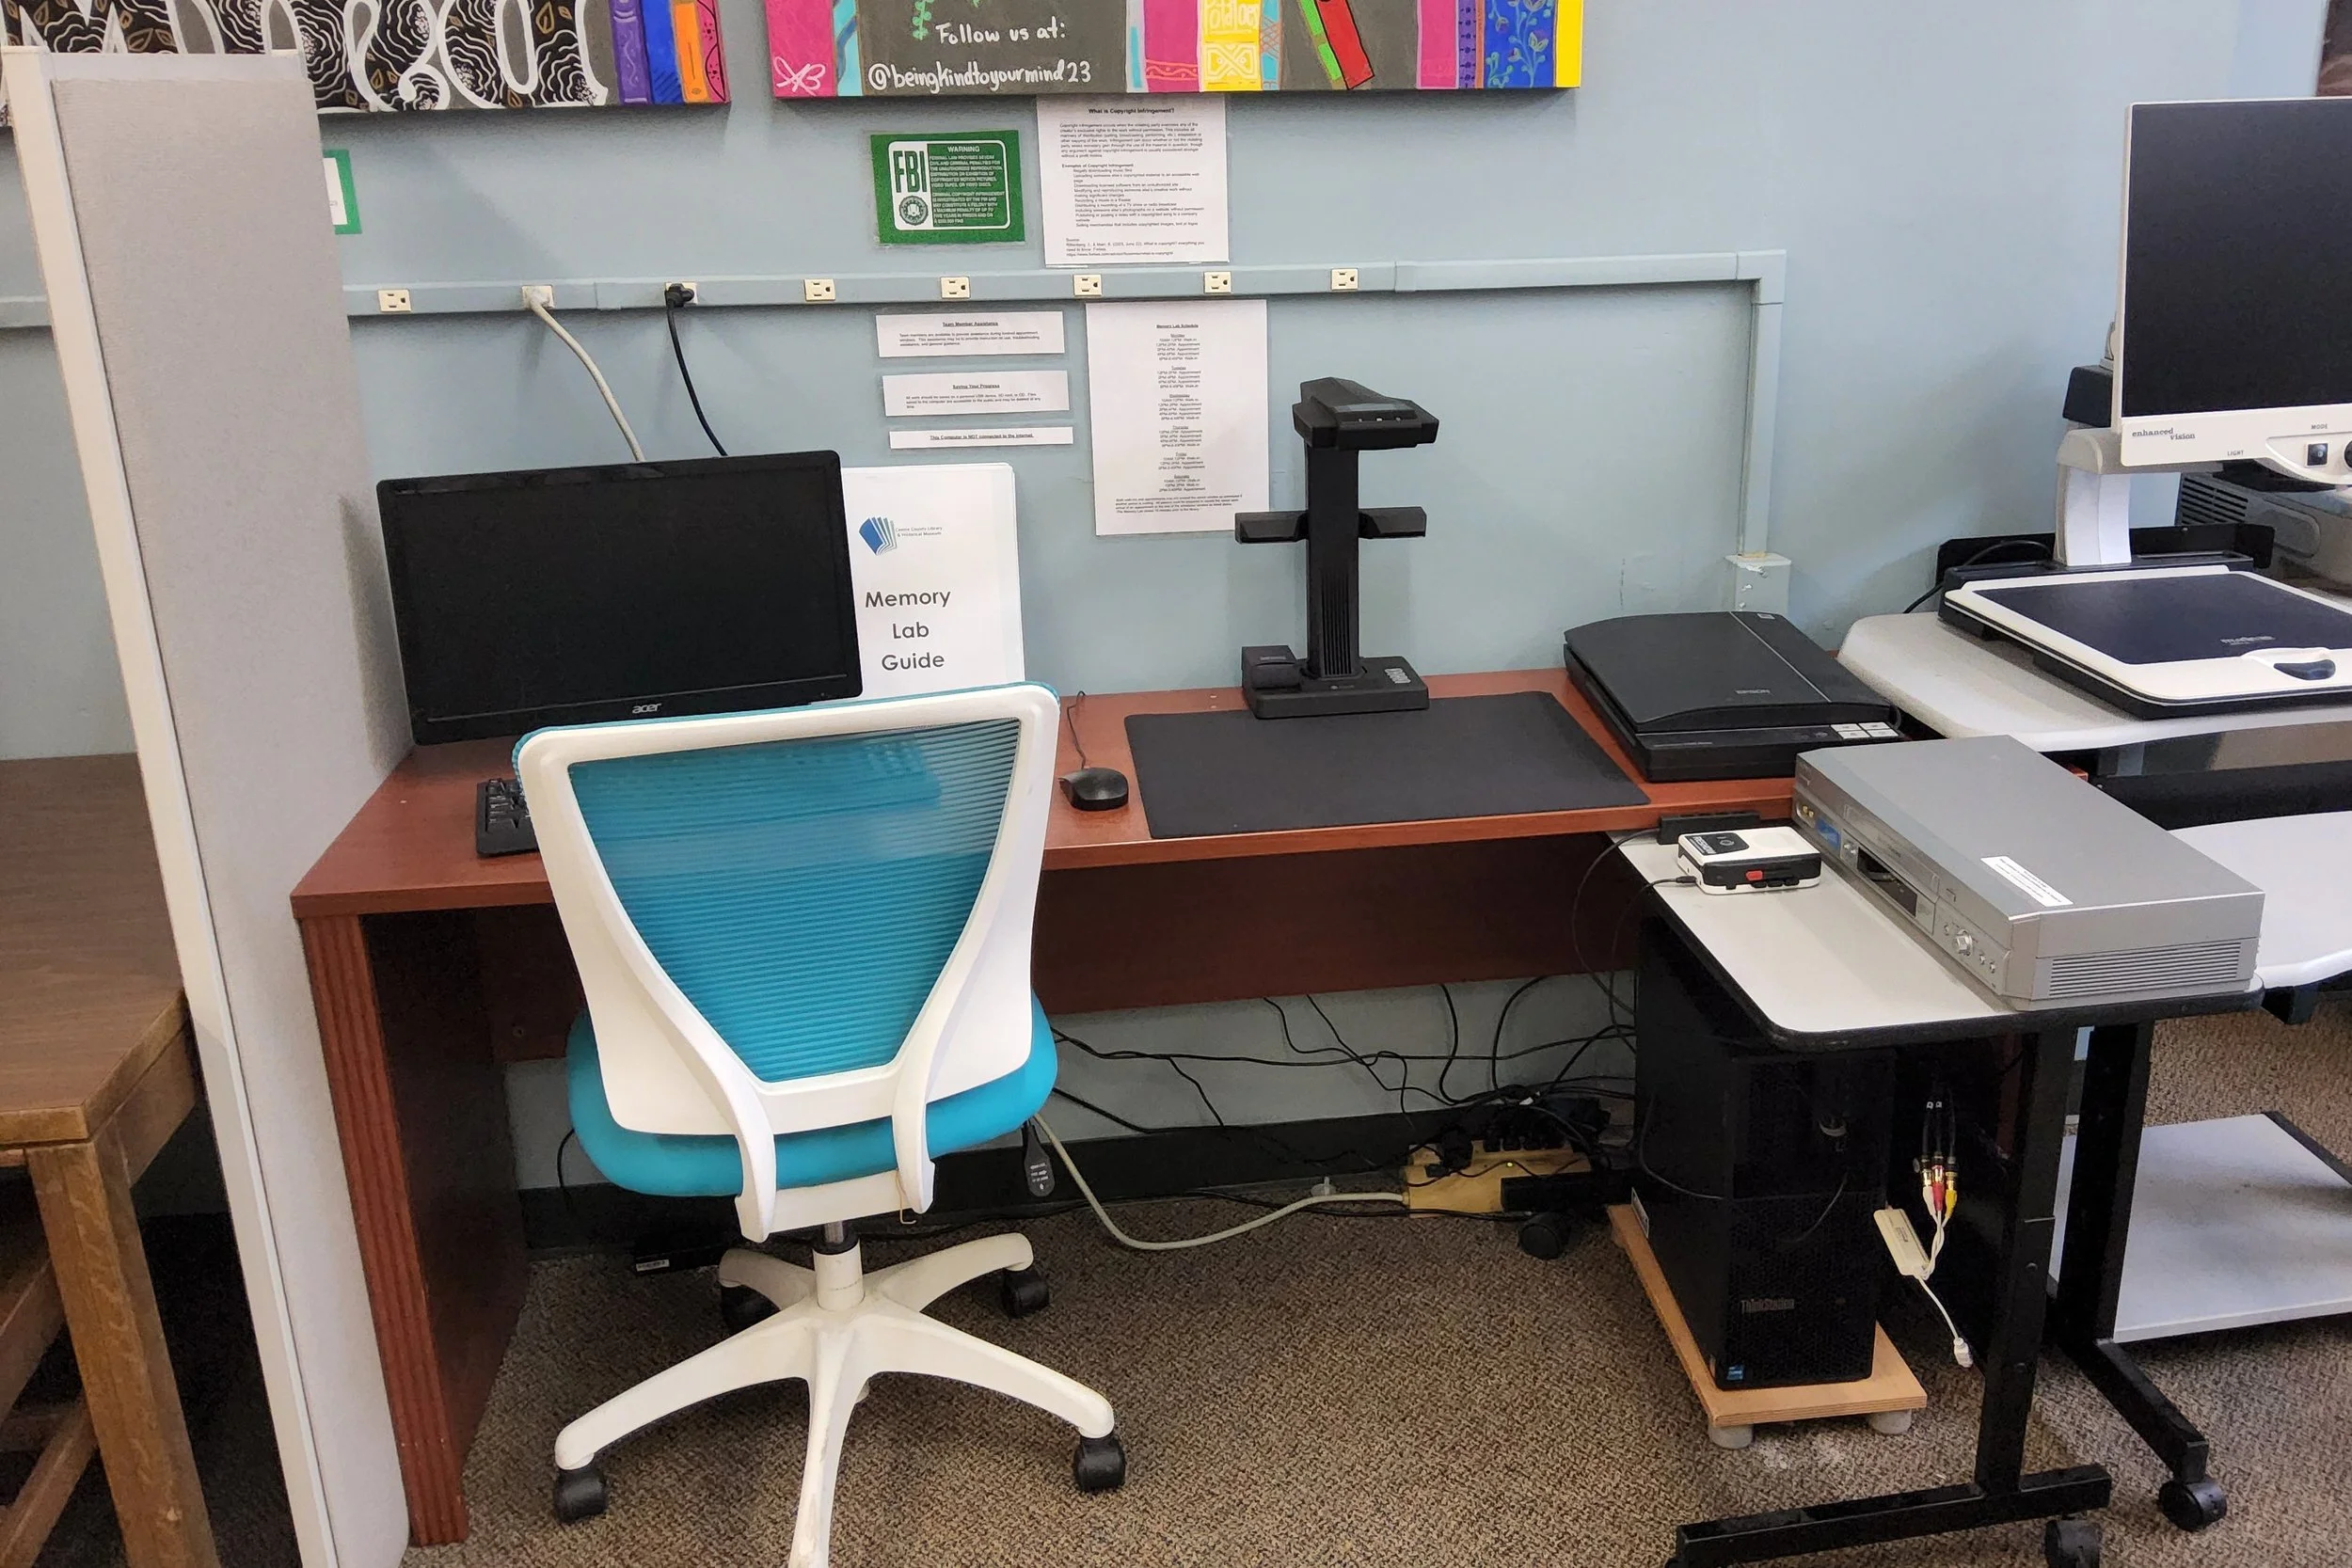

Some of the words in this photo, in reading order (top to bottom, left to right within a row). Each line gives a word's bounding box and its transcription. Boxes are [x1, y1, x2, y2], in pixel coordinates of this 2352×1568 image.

[936, 22, 1000, 45] Follow
[1009, 27, 1028, 41] us
[1037, 16, 1066, 40] at:
[893, 150, 928, 193] FBI
[2132, 427, 2174, 437] enhanced
[2170, 432, 2196, 441] vision
[866, 590, 951, 609] Memory
[893, 622, 930, 640] Lab
[882, 653, 945, 671] Guide
[632, 703, 662, 714] acer
